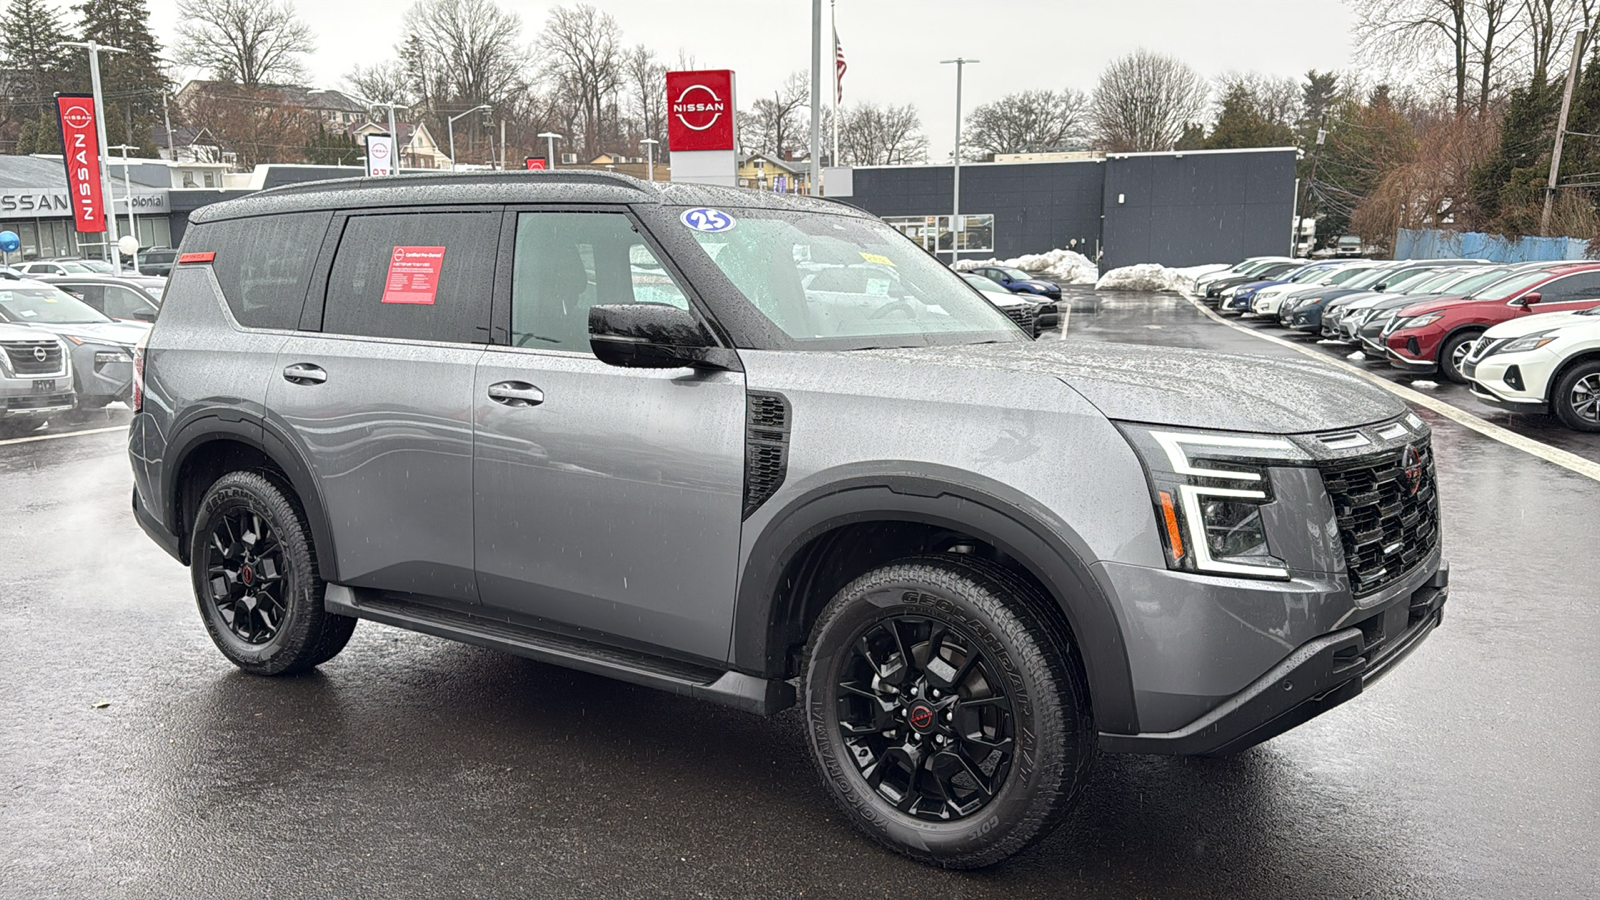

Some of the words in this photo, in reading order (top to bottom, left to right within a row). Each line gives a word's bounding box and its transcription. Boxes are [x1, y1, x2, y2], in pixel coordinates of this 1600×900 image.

[673, 102, 724, 112] NISSAN
[74, 133, 94, 220] NISSAN
[690, 210, 726, 230] 25
[901, 590, 1034, 716] GEOLANDAR
[811, 701, 889, 832] YOKOHAMA
